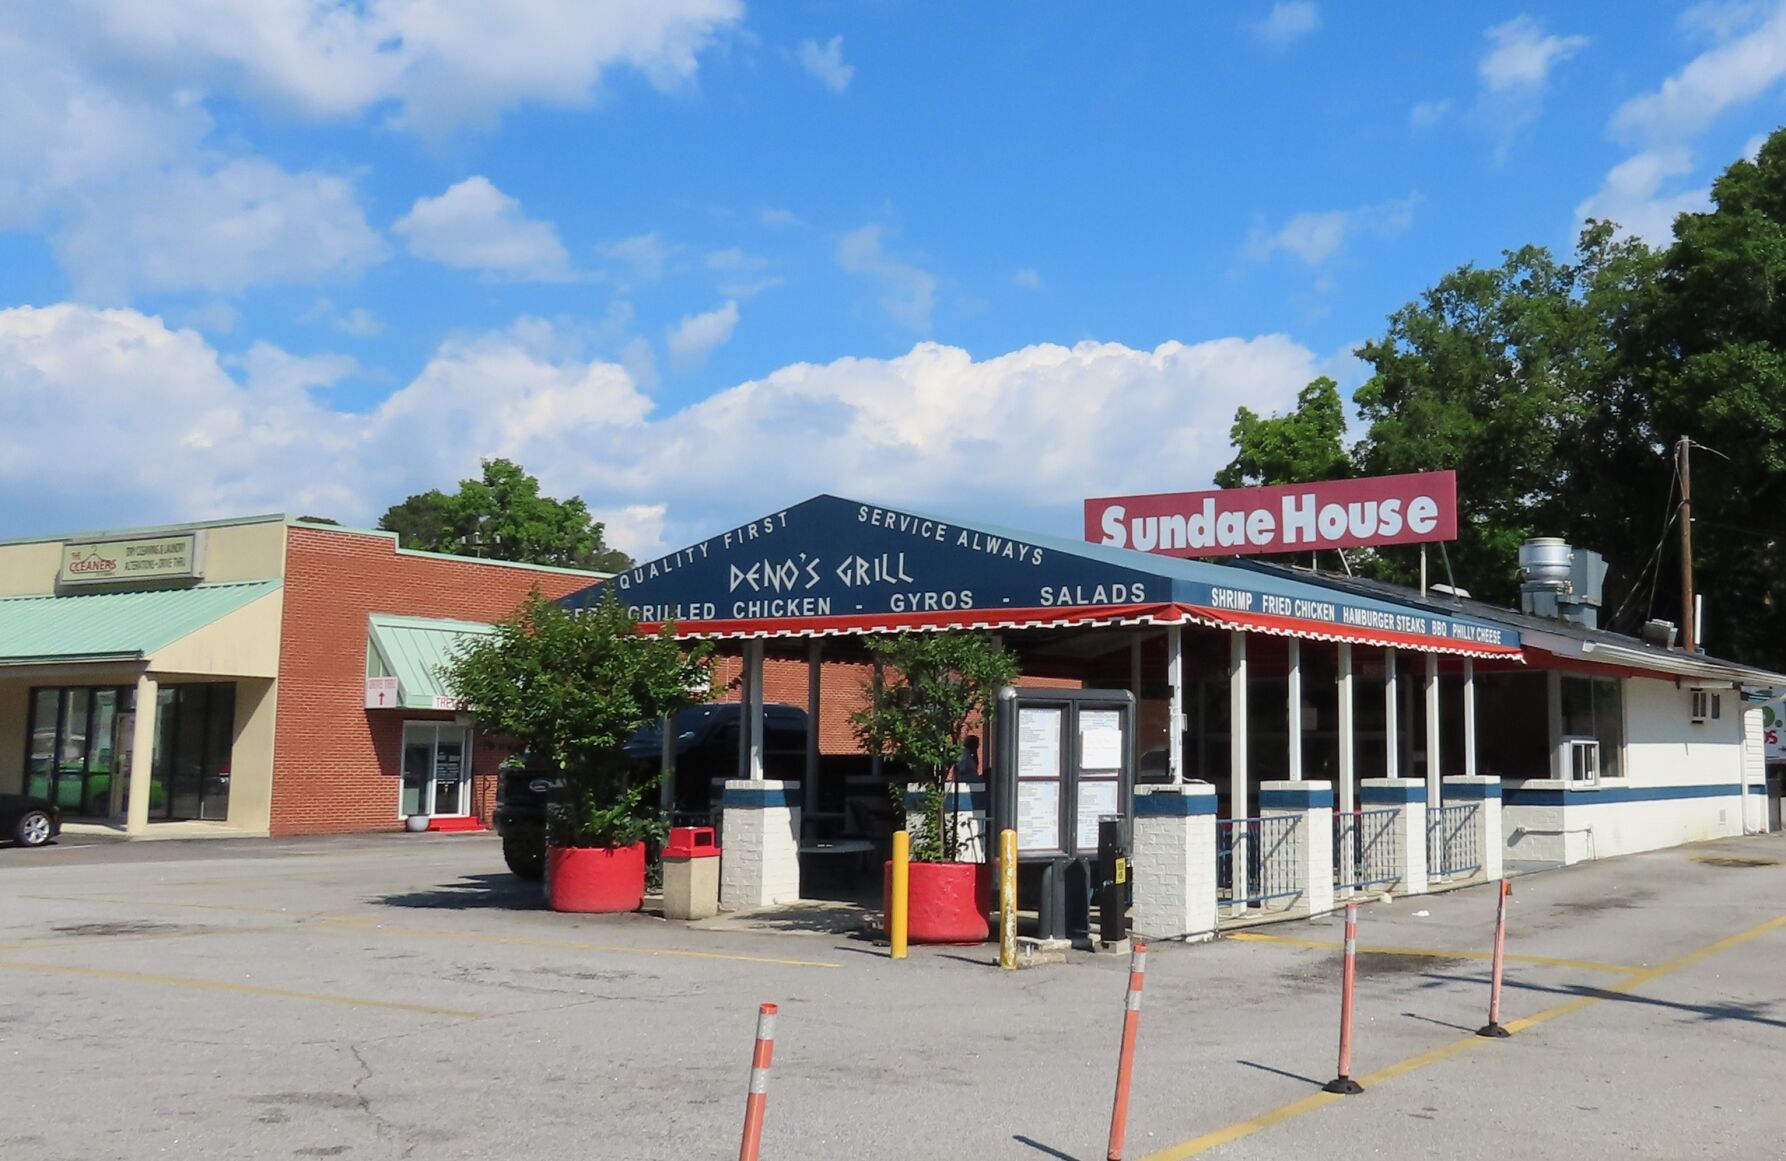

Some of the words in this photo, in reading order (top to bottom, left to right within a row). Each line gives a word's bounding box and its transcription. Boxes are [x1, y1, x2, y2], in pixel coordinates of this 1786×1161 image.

[619, 542, 710, 590] QUALITY
[723, 511, 788, 549] FIRST
[857, 505, 947, 542] SERVICE
[956, 530, 1043, 566] ALWAYS
[1101, 497, 1275, 551] Sundae
[1281, 493, 1438, 544] House
[628, 602, 716, 622] GRILLED
[733, 597, 831, 619] CHICKEN
[890, 590, 973, 612] GYROS
[1039, 582, 1146, 606] SALADS
[729, 552, 820, 594] DENO'S
[835, 552, 915, 587] GRILL
[1211, 587, 1253, 611] SHRIMP
[1262, 595, 1292, 616] FRIED
[1295, 599, 1335, 622] CHICKEN
[1343, 606, 1395, 631] HAMBURGER
[1396, 614, 1426, 634] STEAKS
[1431, 620, 1447, 637] BBQ
[1452, 623, 1476, 641] PHILLY
[1476, 628, 1502, 645] CHEESE
